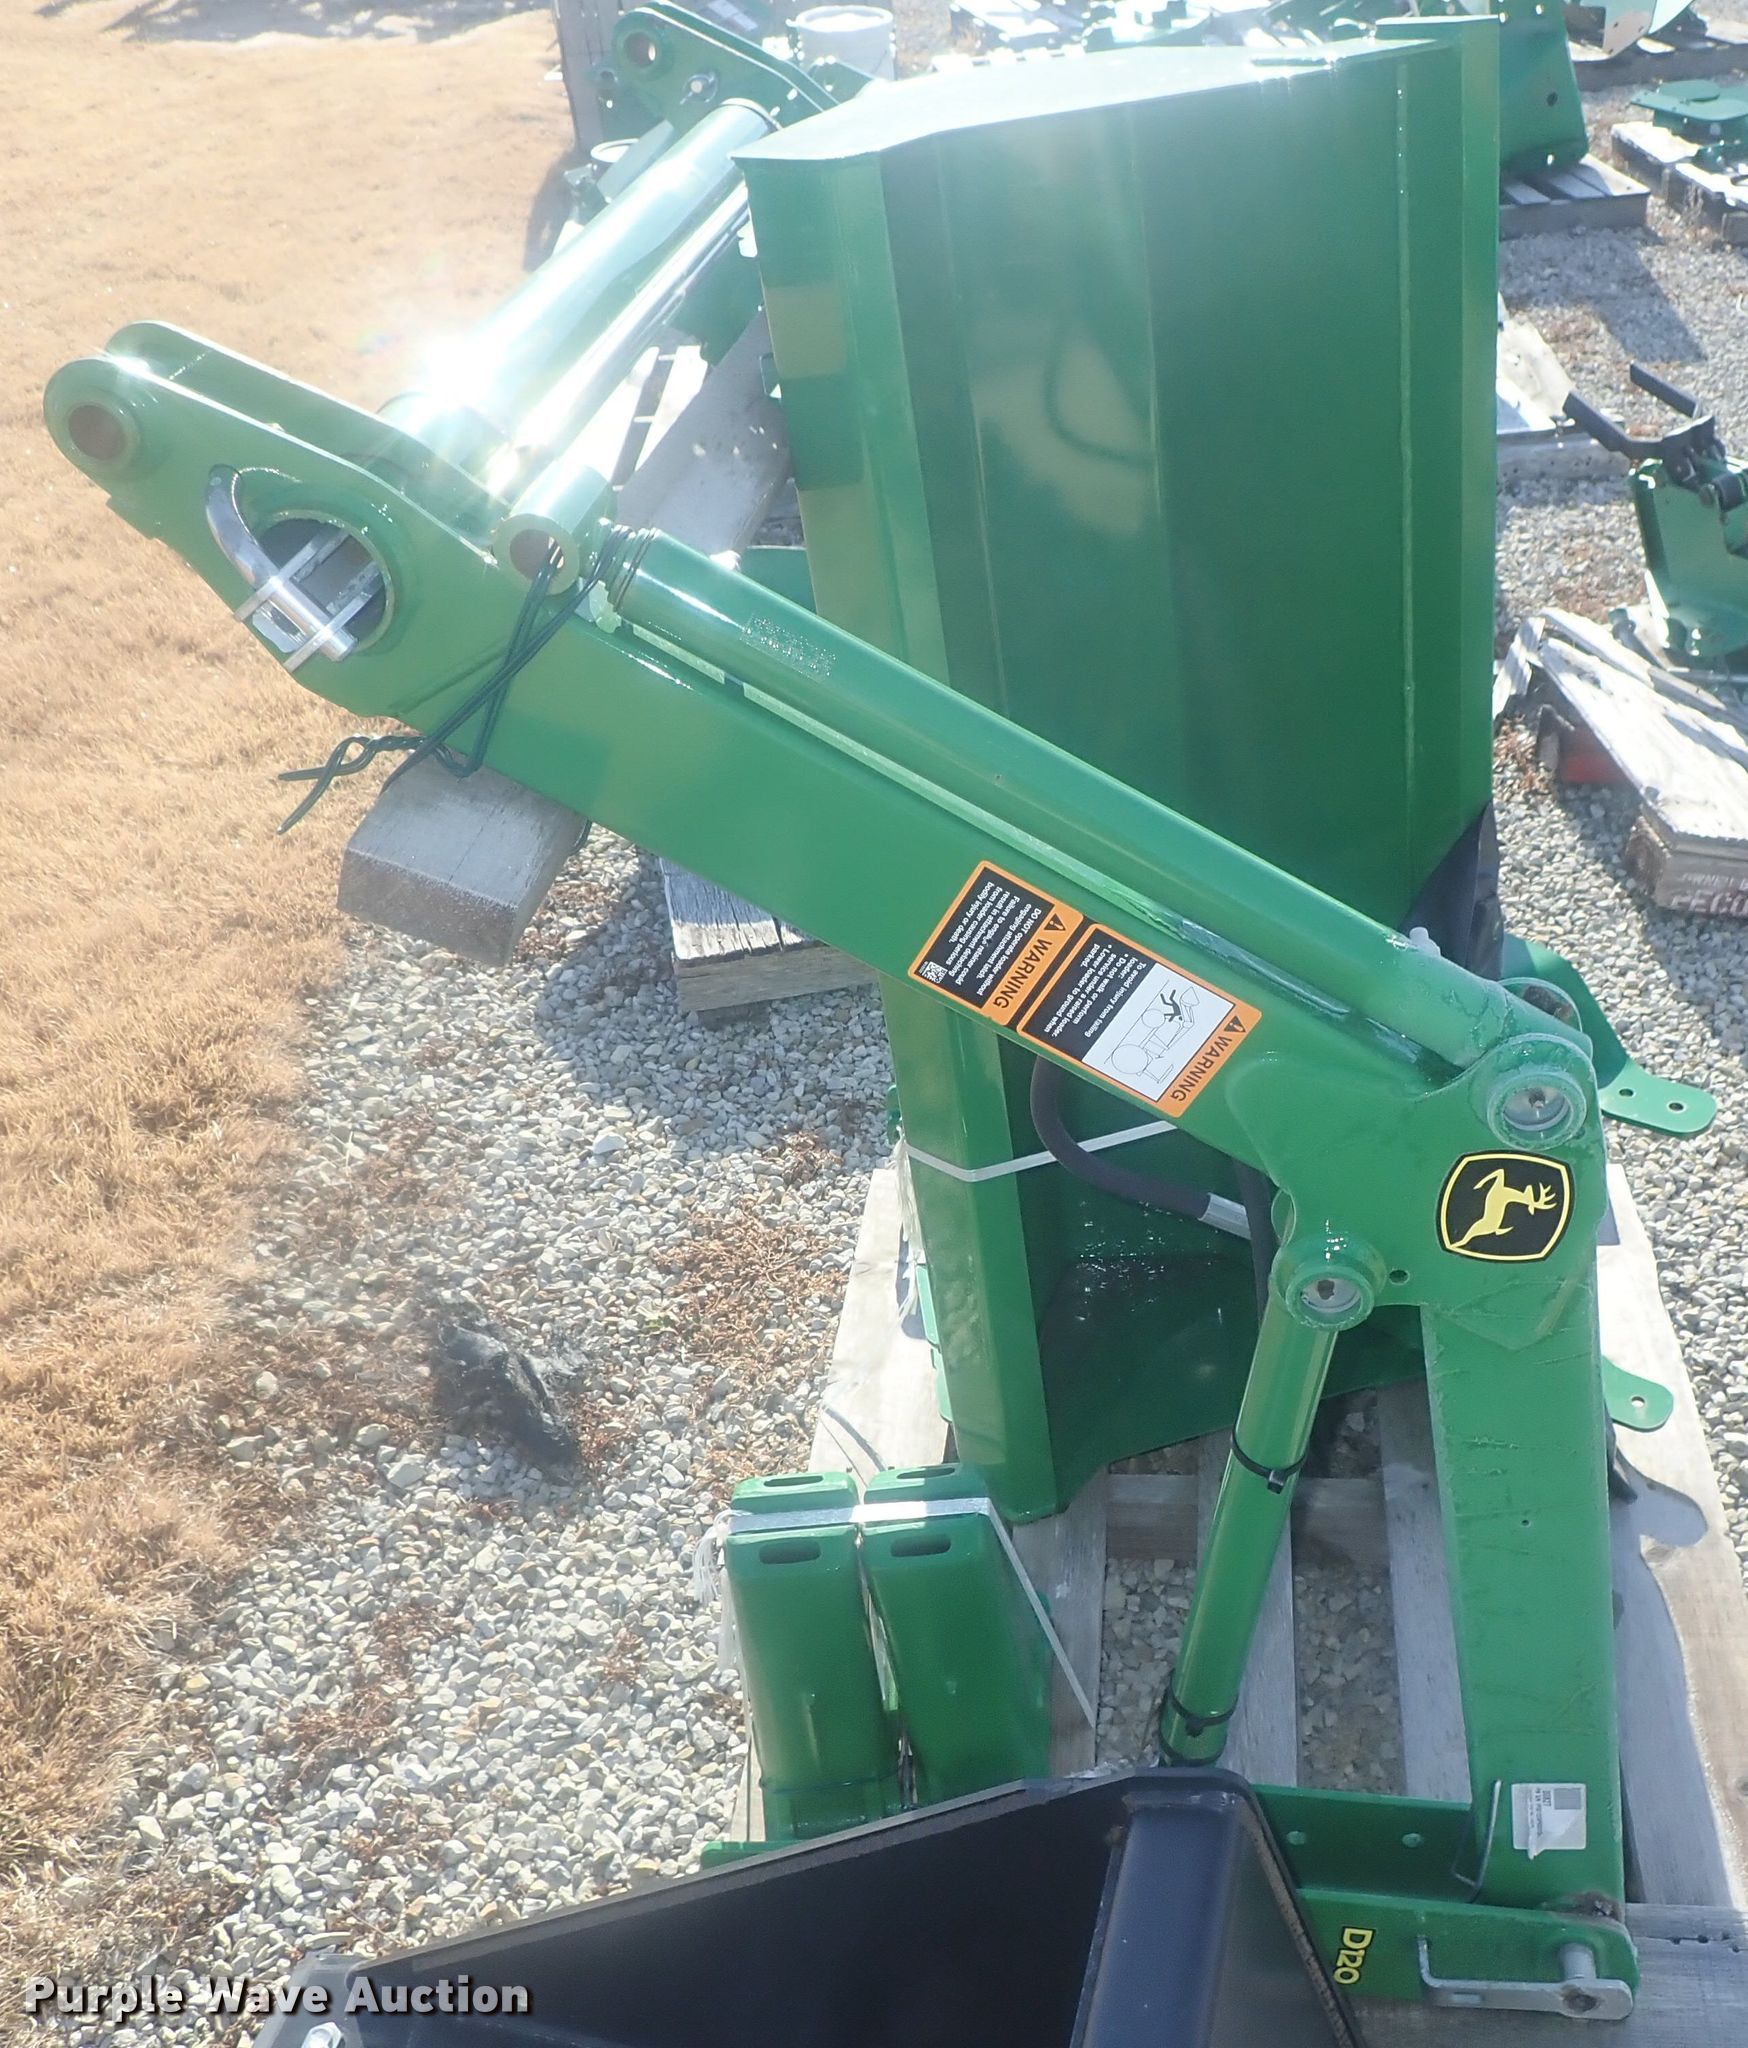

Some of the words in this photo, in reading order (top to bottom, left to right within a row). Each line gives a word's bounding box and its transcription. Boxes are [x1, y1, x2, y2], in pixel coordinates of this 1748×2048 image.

[977, 881, 994, 900] bodily
[989, 886, 1003, 901] from
[996, 891, 1011, 908] result
[966, 900, 982, 917] injury
[976, 901, 993, 920] loader
[1002, 896, 1020, 917] Failure
[1031, 908, 1042, 919] DO
[997, 916, 1006, 924] to
[1010, 903, 1032, 930] engaging
[1021, 918, 1034, 933] NOT
[949, 924, 965, 943] death.
[960, 919, 979, 943] causing
[969, 915, 995, 948] attachment
[988, 931, 1014, 963] attachment
[1004, 931, 1024, 955] operate
[946, 943, 964, 964] serious
[949, 947, 972, 976] detaching
[967, 945, 986, 967] retainer
[1079, 944, 1102, 967] parked.
[1092, 948, 1110, 967] Lower
[1116, 957, 1126, 967] Do
[977, 963, 991, 979] latch.
[993, 955, 1009, 973] loader
[993, 936, 1052, 1009] WARNING
[1098, 953, 1118, 975] service
[1108, 967, 1119, 978] not
[1118, 957, 1138, 978] loader:
[1136, 961, 1147, 970] To
[956, 967, 971, 984] could
[978, 973, 996, 995] without
[1077, 967, 1096, 987] loader
[1085, 975, 1101, 993] under
[1123, 970, 1140, 987] avoid
[1096, 978, 1111, 993] walk
[1109, 986, 1127, 1004] injury
[1055, 994, 1076, 1016] ground
[1066, 998, 1084, 1017] raised
[1072, 999, 1094, 1024] perform
[1099, 1004, 1113, 1018] from
[1044, 1016, 1059, 1032] when
[1052, 1017, 1070, 1037] loader.
[1084, 1018, 1103, 1037] falling
[1171, 1034, 1233, 1102] WARNING
[1333, 1926, 1376, 1985] D120
